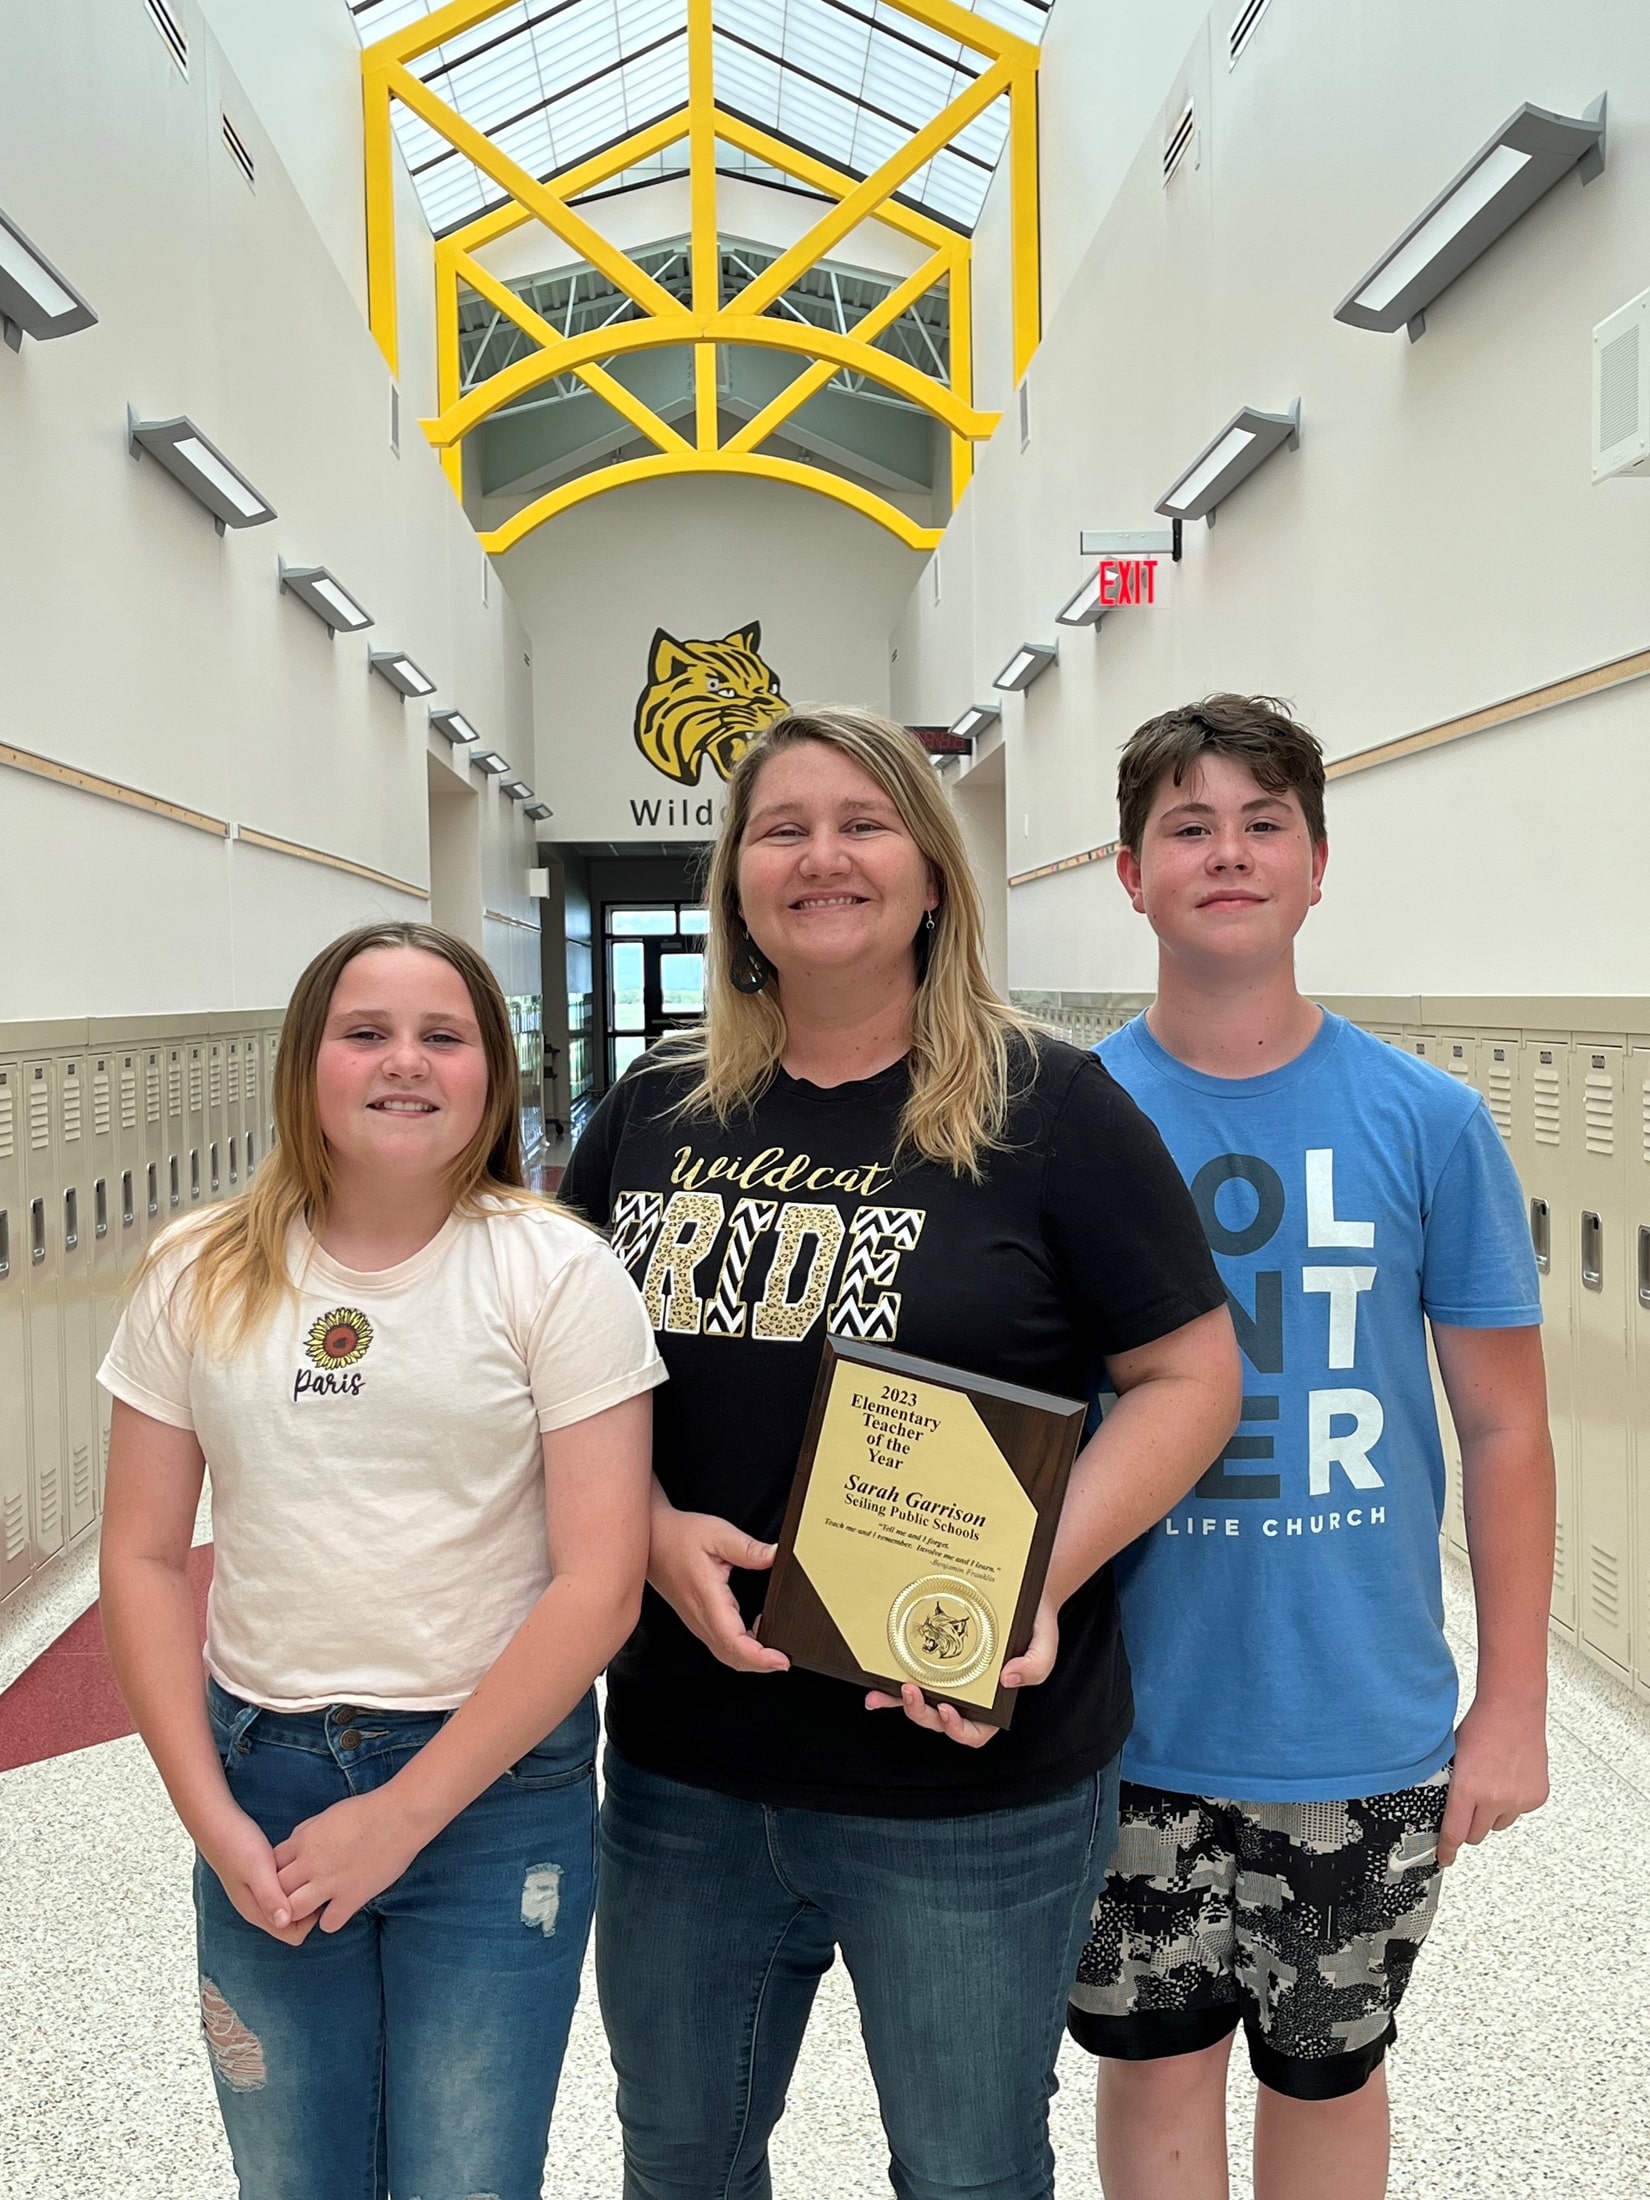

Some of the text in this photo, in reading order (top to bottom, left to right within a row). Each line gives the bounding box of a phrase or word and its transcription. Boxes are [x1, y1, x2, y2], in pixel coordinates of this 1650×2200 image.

[1099, 559, 1158, 606] EXIT
[671, 1146, 893, 1196] Wildcat
[611, 1190, 927, 1342] PRIDE
[851, 1393, 941, 1433] Elementary
[880, 1385, 918, 1408] 2023
[863, 1412, 924, 1442] Teacher
[866, 1433, 911, 1455] of the
[868, 1447, 904, 1470] Year
[844, 1474, 987, 1528] Sarah Garrison
[844, 1493, 980, 1542] Seiling Public Schools
[895, 1529, 907, 1537] me
[907, 1532, 922, 1541] and
[1166, 1506, 1386, 1537] LIFE CHURCH
[825, 1517, 845, 1529] Teach
[845, 1525, 857, 1533] me
[857, 1529, 873, 1537] and
[916, 1544, 943, 1558] Involve
[943, 1553, 955, 1561] me
[955, 1557, 971, 1567] and
[965, 1568, 996, 1583] Franklin
